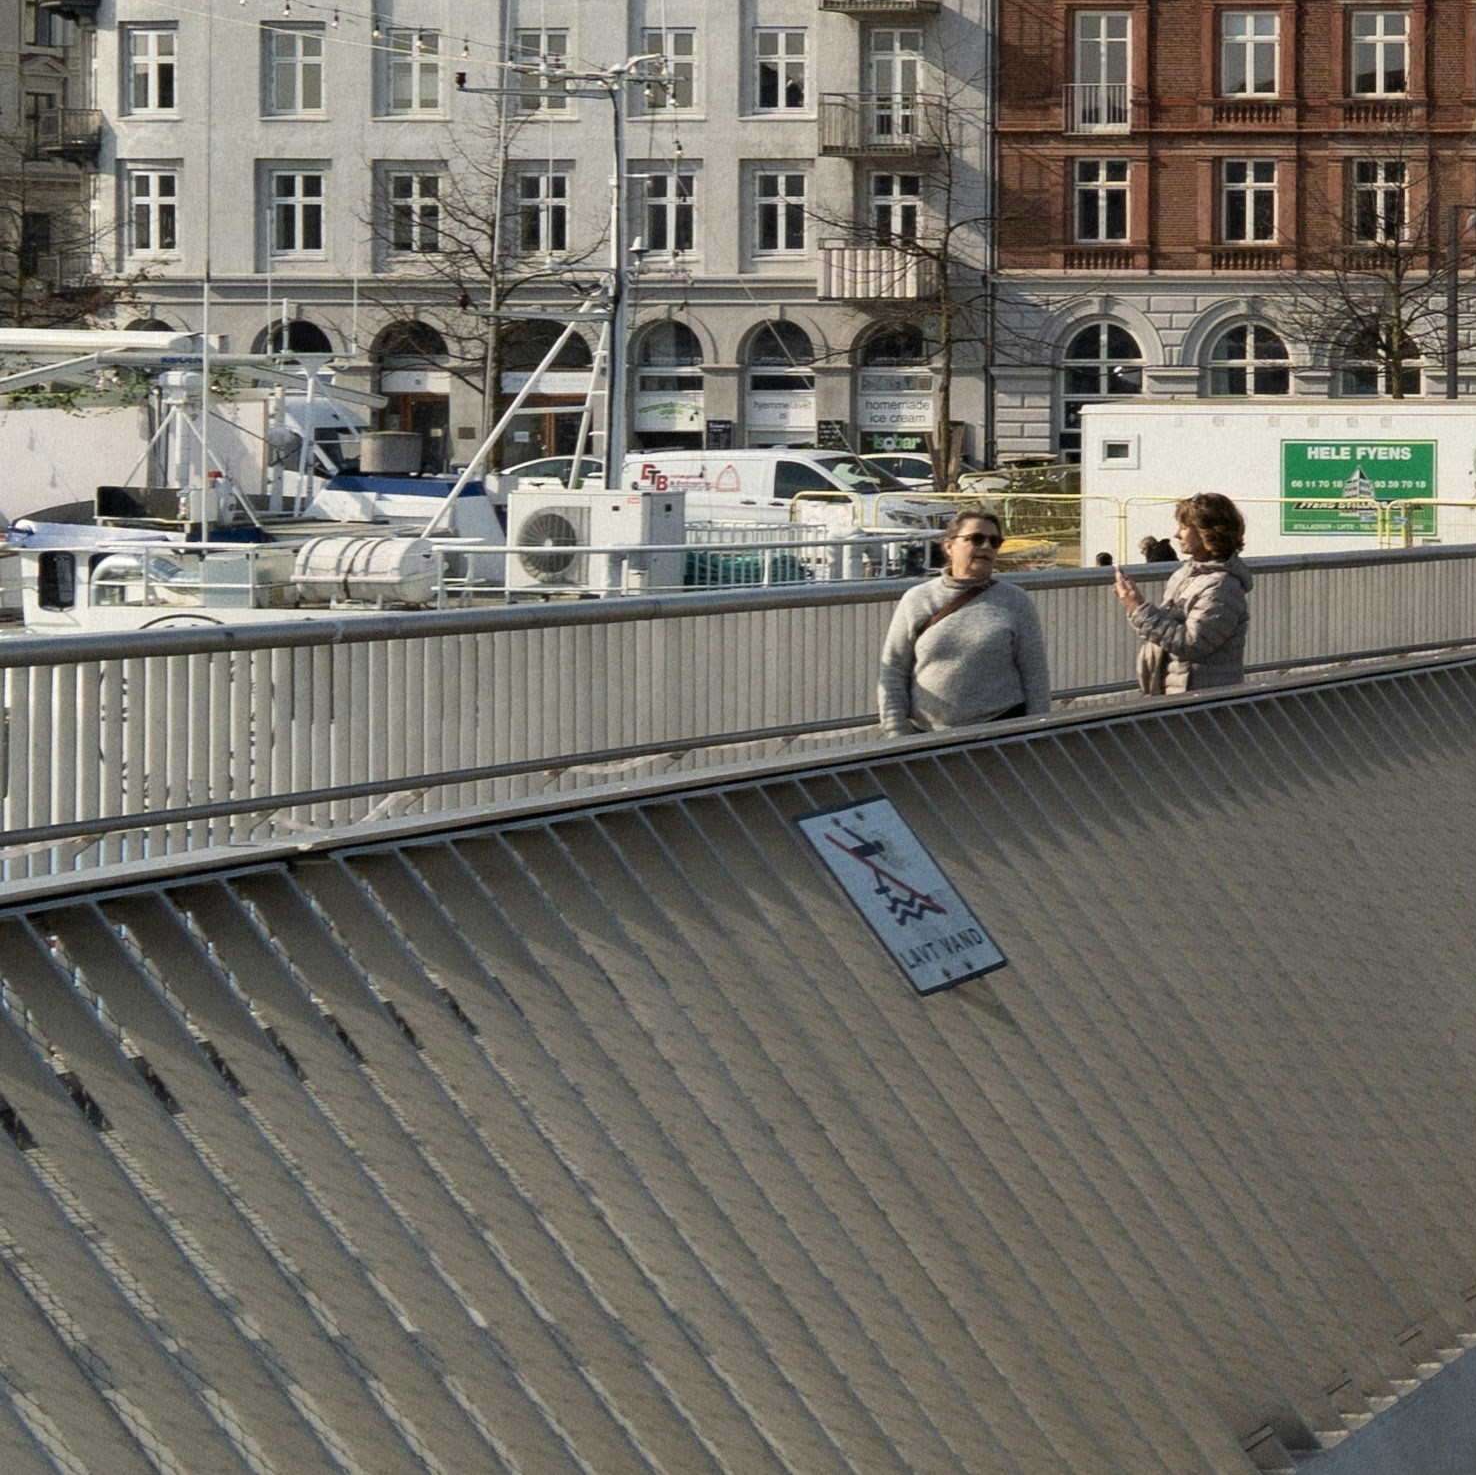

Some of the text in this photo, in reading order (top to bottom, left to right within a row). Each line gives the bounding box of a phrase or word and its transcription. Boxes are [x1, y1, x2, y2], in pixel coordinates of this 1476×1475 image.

[865, 399, 930, 411] homemade
[870, 413, 926, 423] ice cream
[1307, 446, 1412, 460] HELE FYENS
[1305, 480, 1315, 488] 11
[1318, 480, 1329, 488] 70
[1401, 480, 1413, 488] 70
[1416, 480, 1426, 488] 18
[899, 928, 983, 969] LAVT VAND
